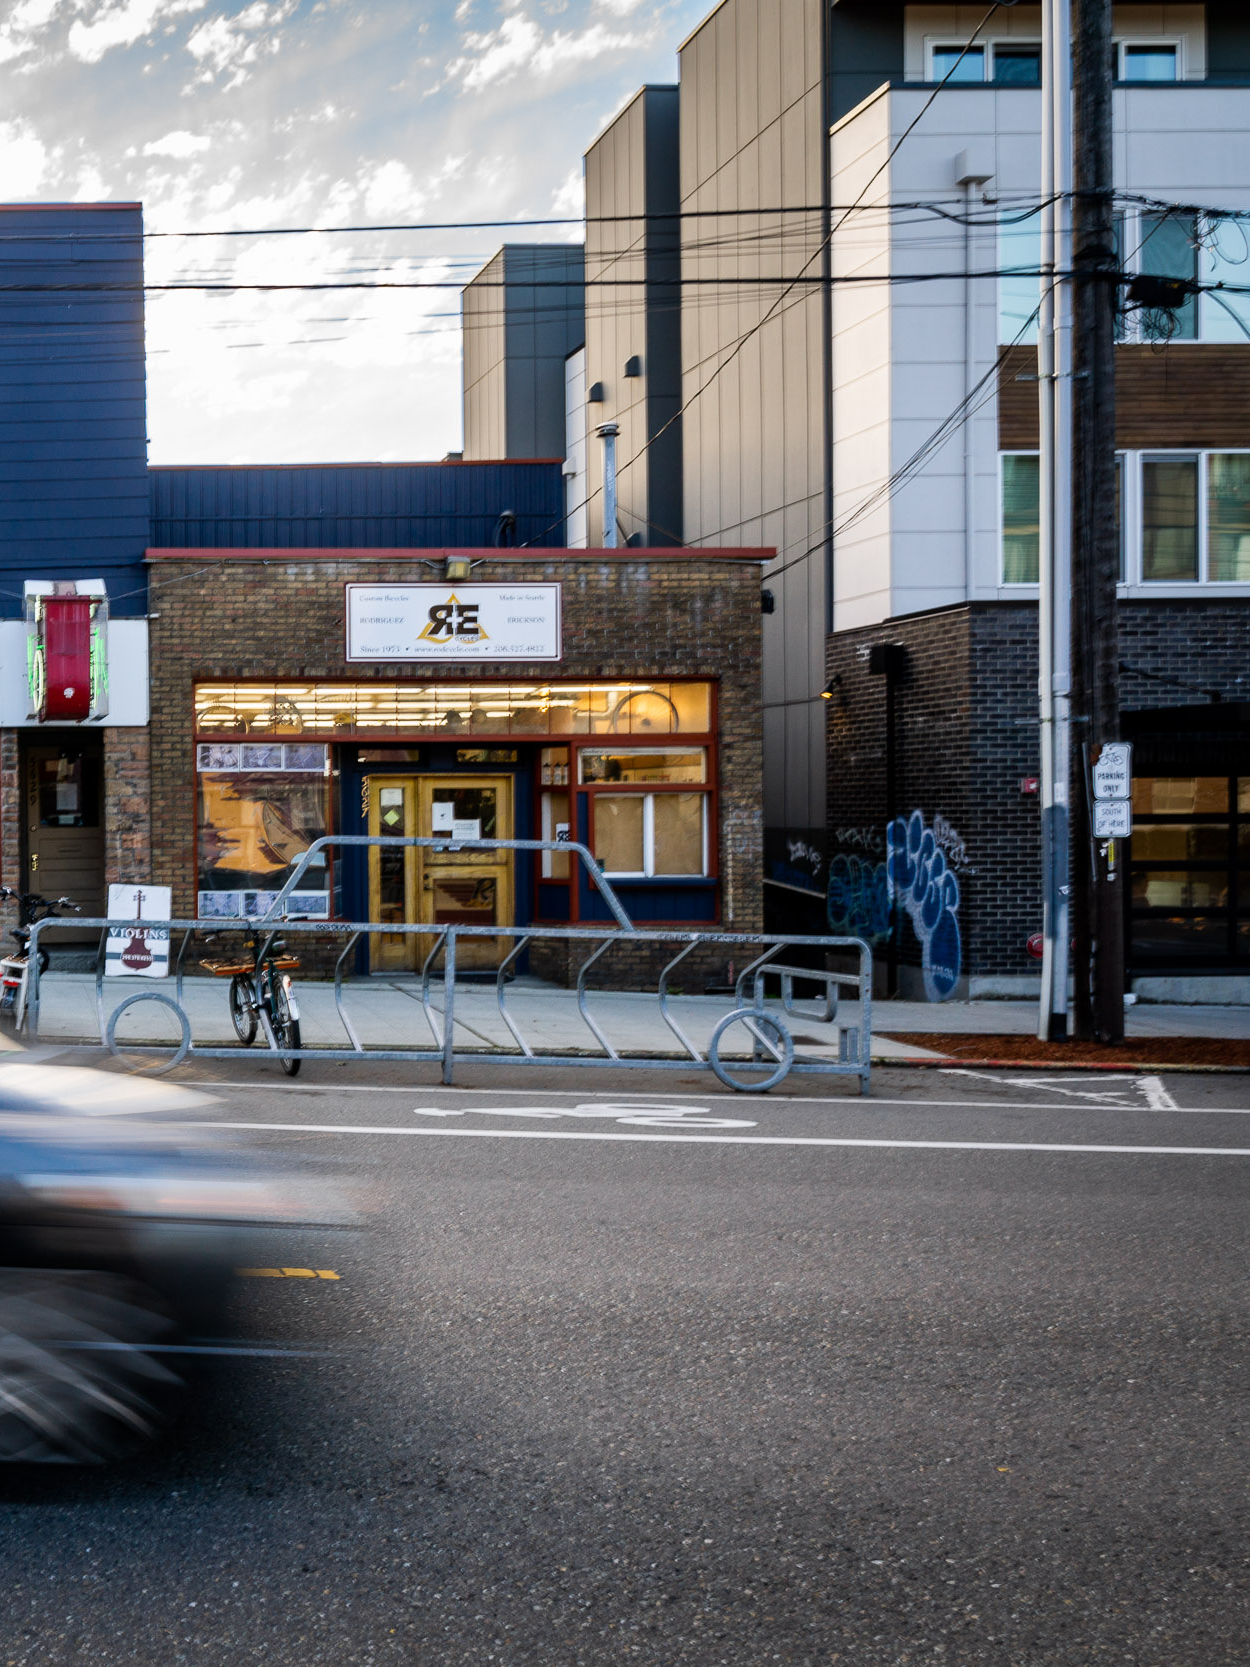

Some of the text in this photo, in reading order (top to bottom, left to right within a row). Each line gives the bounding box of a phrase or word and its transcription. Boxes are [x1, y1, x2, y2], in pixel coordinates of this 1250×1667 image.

[360, 645, 379, 653] Since
[1097, 772, 1125, 781] PARKING
[1103, 784, 1119, 793] ONLY
[1101, 808, 1122, 816] SOUTH
[110, 927, 168, 940] VIOLINS
